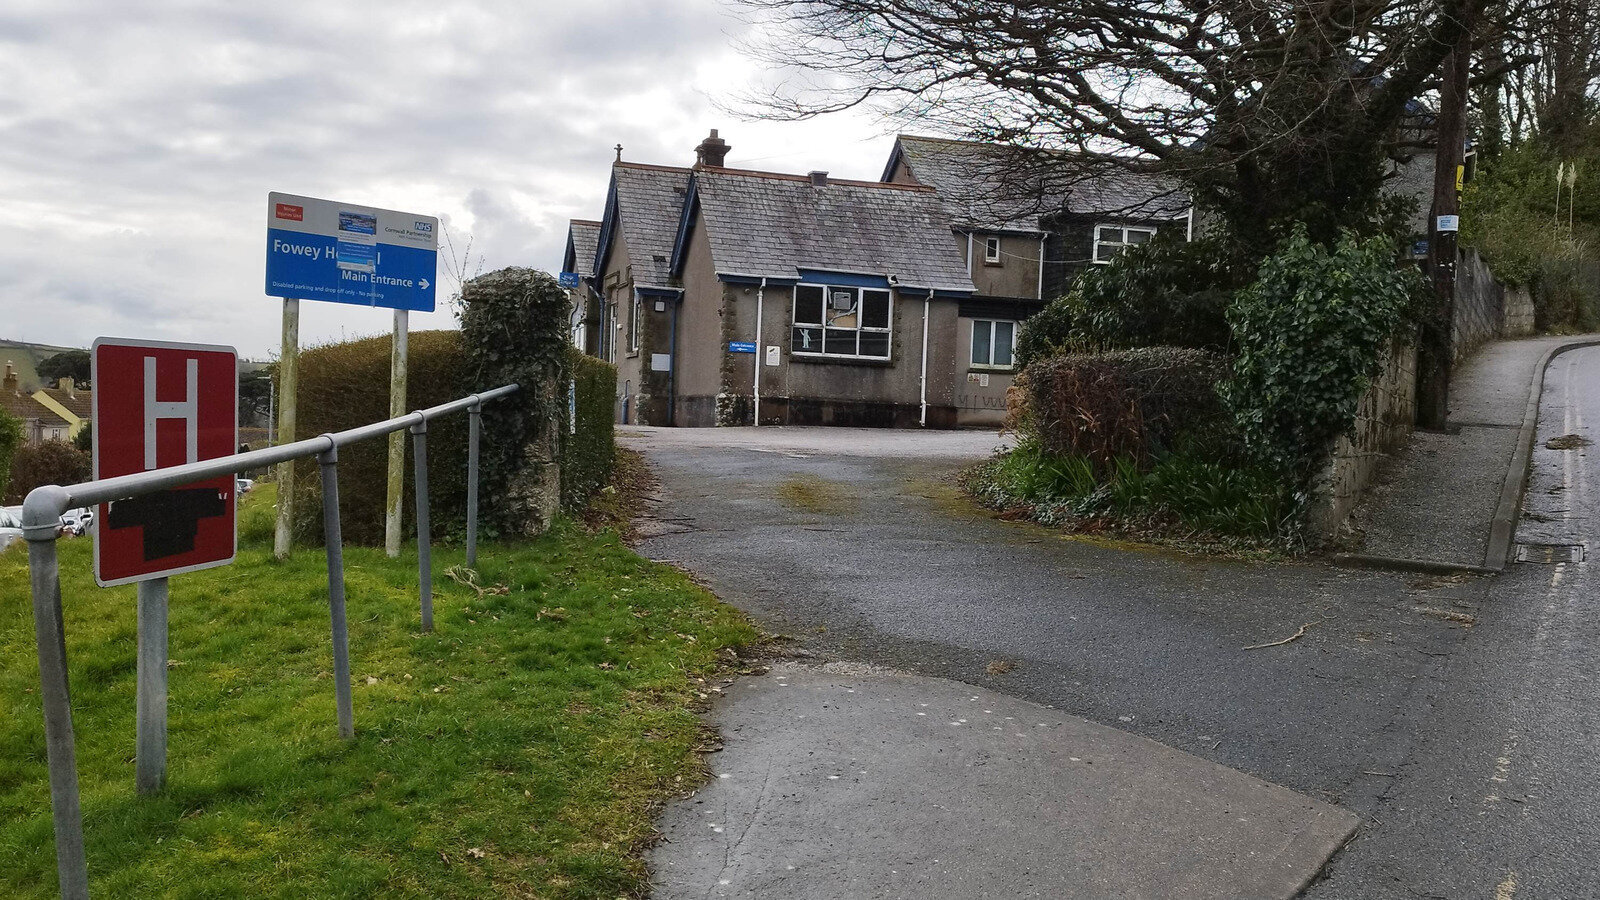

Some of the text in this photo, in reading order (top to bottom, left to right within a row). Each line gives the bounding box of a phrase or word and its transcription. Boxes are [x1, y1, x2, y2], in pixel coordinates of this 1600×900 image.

[415, 222, 431, 231] NHS
[274, 239, 321, 260] Fowey
[272, 281, 294, 289] Disabled
[295, 283, 314, 292] parking
[325, 286, 336, 294] drop
[342, 270, 413, 288] Main Entrance
[144, 356, 198, 470] H
